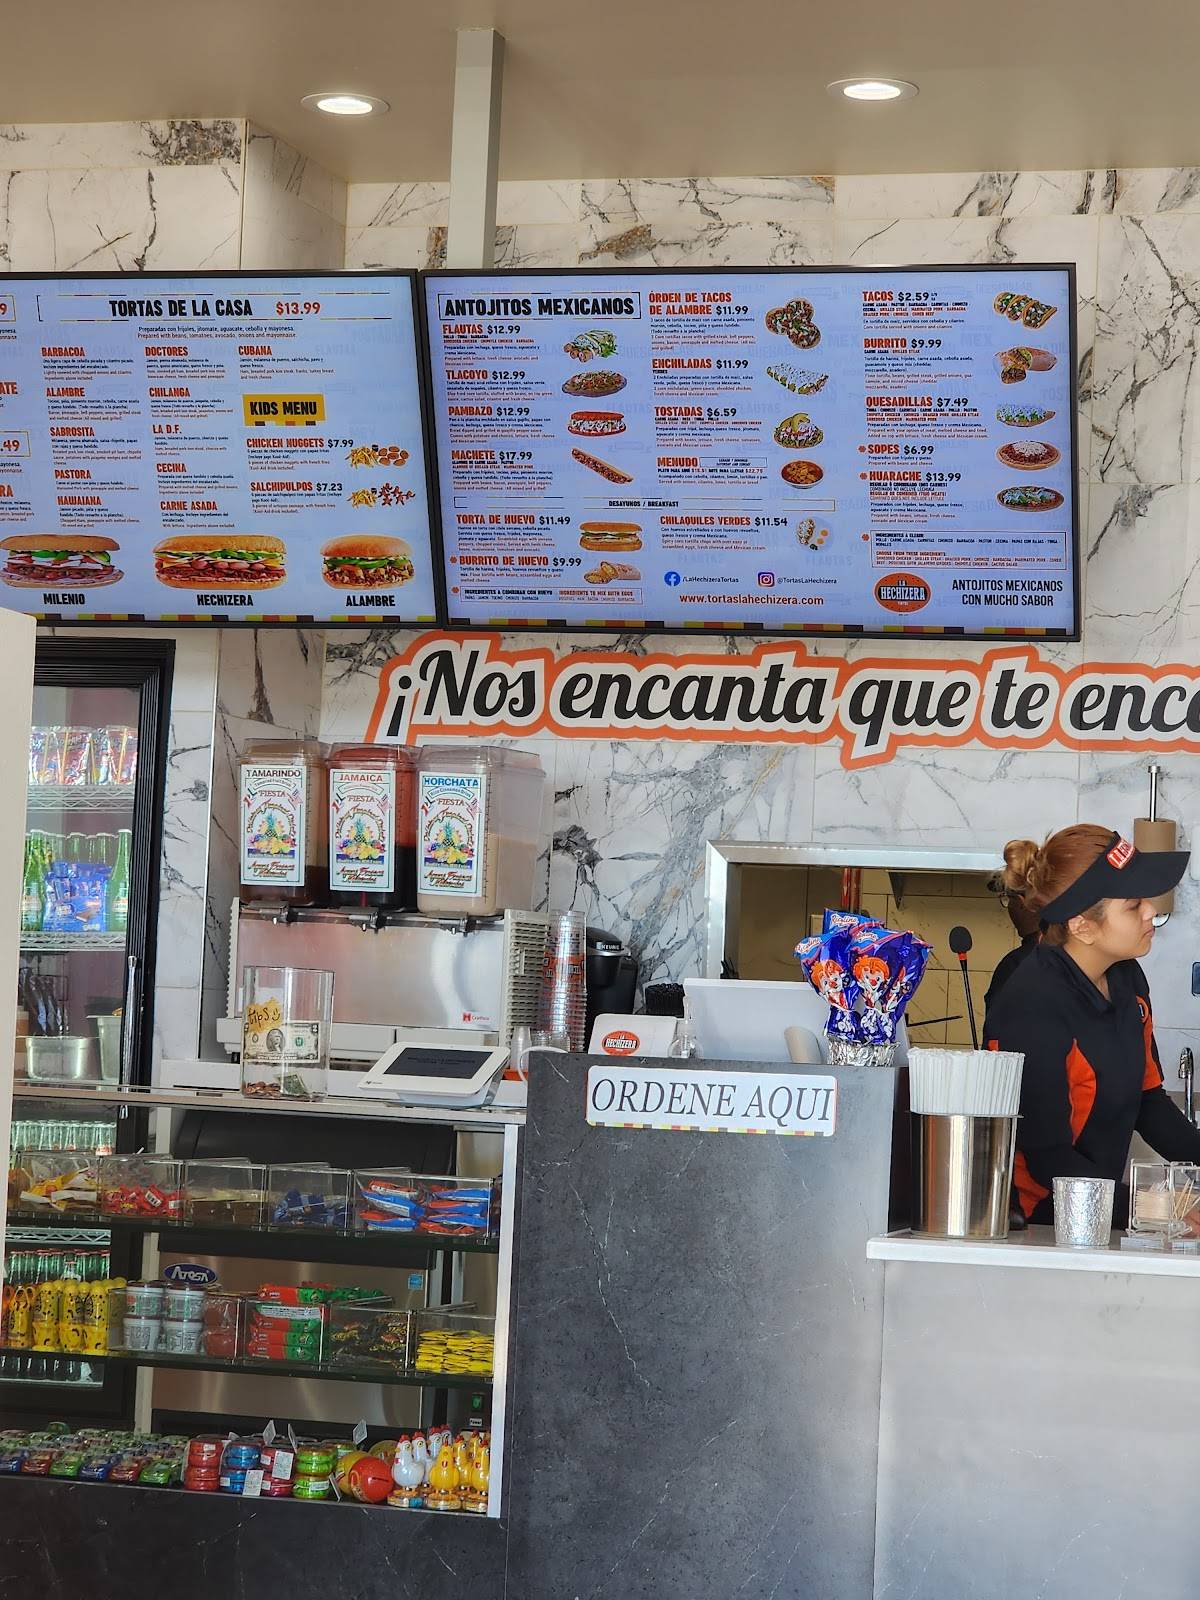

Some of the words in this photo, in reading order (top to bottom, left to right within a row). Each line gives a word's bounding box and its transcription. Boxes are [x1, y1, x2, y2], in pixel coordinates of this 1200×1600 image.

[685, 293, 697, 302] DE
[701, 293, 731, 302] TACOS
[863, 292, 893, 300] TACOS
[898, 292, 929, 301] $2.59
[109, 301, 162, 316] TORTAS
[168, 300, 187, 316] DE
[192, 300, 210, 316] LA
[216, 300, 252, 316] CASA
[276, 301, 320, 315] $13.99
[445, 299, 532, 316] ANTOJITOS
[538, 298, 634, 315] MEXICANOS
[650, 305, 662, 314] DE
[666, 305, 711, 314] ALAMBRE
[716, 305, 748, 315] $11.99
[443, 325, 483, 333] FLAUTAS
[487, 325, 520, 334] $12.99
[864, 339, 906, 347] BURRITO
[911, 339, 941, 348] $9.99
[42, 347, 85, 356] BARBACOA
[145, 347, 188, 356] DOCTORES
[239, 346, 272, 355] CUBANA
[652, 359, 711, 369] ENCHILADAS
[716, 360, 748, 369] $11.99
[446, 370, 487, 379] TLACOYO
[492, 371, 525, 380] $12.99
[46, 388, 85, 397] ALAMBRE
[149, 388, 190, 397] CHILANGA
[867, 397, 932, 407] QUESADILLAS
[937, 398, 968, 407] $7.49
[250, 401, 278, 415] KIDS
[283, 401, 317, 415] MENU
[449, 407, 492, 415] PAMBAZO
[497, 407, 529, 416] $12.99
[655, 407, 702, 416] TOSTADAS
[707, 408, 736, 417] $6.59
[50, 427, 94, 436] SABROSITA
[153, 425, 163, 433] LA
[166, 425, 181, 433] D.F.
[247, 438, 283, 447] CHICKEN
[286, 438, 324, 447] NUGGETS
[328, 438, 353, 447] $7.99
[868, 445, 899, 454] SOPES
[904, 445, 934, 454] $6.99
[452, 451, 495, 459] MACHETE
[499, 451, 532, 460] $17.99
[658, 458, 697, 467] MENUDO
[157, 463, 186, 472] CECINA
[55, 470, 91, 479] PASTORA
[870, 472, 921, 481] HUARACHE
[925, 473, 961, 481] $13.99
[251, 482, 312, 491] SALCHIPULPOS
[316, 482, 342, 491] $7.23
[160, 501, 187, 510] CARNE
[191, 501, 217, 510] ASADA
[456, 515, 485, 524] TORTA
[489, 515, 501, 524] DE
[504, 515, 534, 524] HUEVO
[539, 516, 570, 525] $11.49
[660, 516, 714, 525] CHILAQUILES
[718, 517, 750, 525] VERDES
[755, 517, 787, 526] $11.54
[460, 557, 499, 565] BURRITO
[503, 557, 514, 565] DE
[518, 557, 548, 565] HUEVO
[553, 557, 581, 567] $9.99
[952, 580, 1003, 591] ANTOJITOS
[1006, 581, 1062, 591] MEXICANOS
[880, 587, 925, 600] HECHIZERA
[43, 594, 85, 604] MILENIO
[197, 595, 253, 606] HECHIZERA
[346, 595, 395, 606] ALAMBRE
[680, 594, 823, 605] www.tortaslahechizera.com
[962, 595, 981, 605] CON
[984, 596, 1018, 605] MUCHO
[1022, 596, 1053, 606] SABOR
[387, 650, 536, 736] ¡Nos
[559, 664, 825, 722] encanta
[848, 676, 967, 748] que
[993, 660, 1050, 729] te
[340, 774, 383, 782] JAMAICA
[424, 778, 478, 787] HORCHATA
[438, 798, 464, 806] FIESTA
[592, 1079, 736, 1116] ORDENE
[742, 1086, 834, 1127] AQUI
